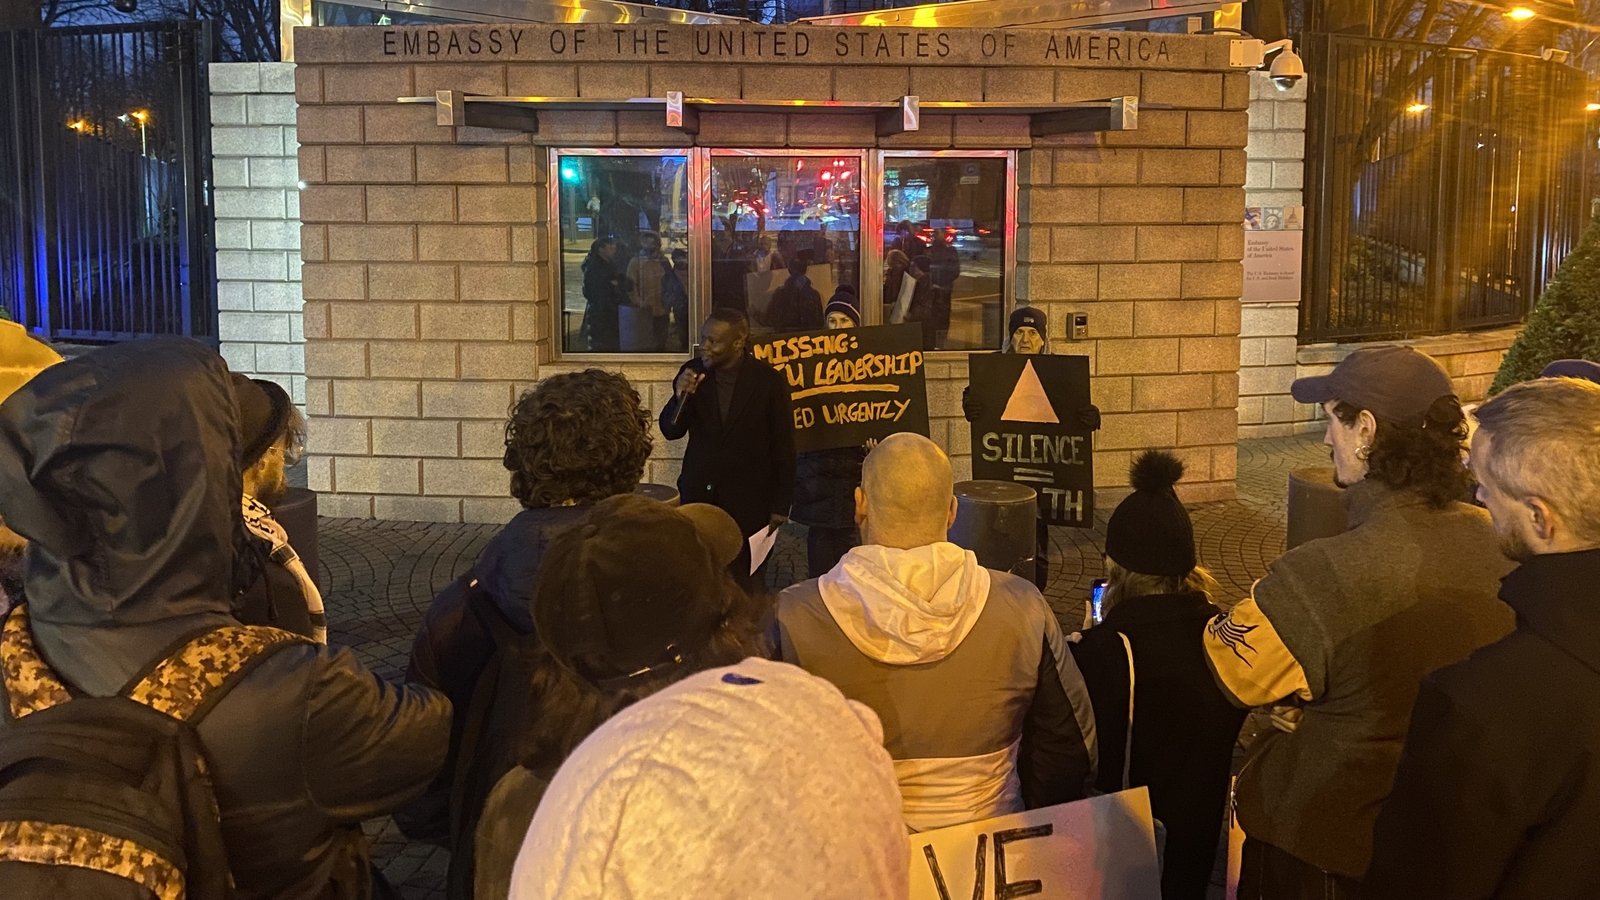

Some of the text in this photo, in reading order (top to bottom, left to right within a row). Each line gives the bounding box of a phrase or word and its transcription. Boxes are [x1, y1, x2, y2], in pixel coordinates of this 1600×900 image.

[383, 29, 1171, 62] EMBASSY OF THE UNITED STATES OF AMERICA
[753, 333, 859, 365] MISSING:
[773, 350, 924, 388] U LEADERSHIP
[792, 398, 911, 430] ED URGENTLY
[981, 431, 1085, 466] SILENCE
[1041, 486, 1083, 522] TH
